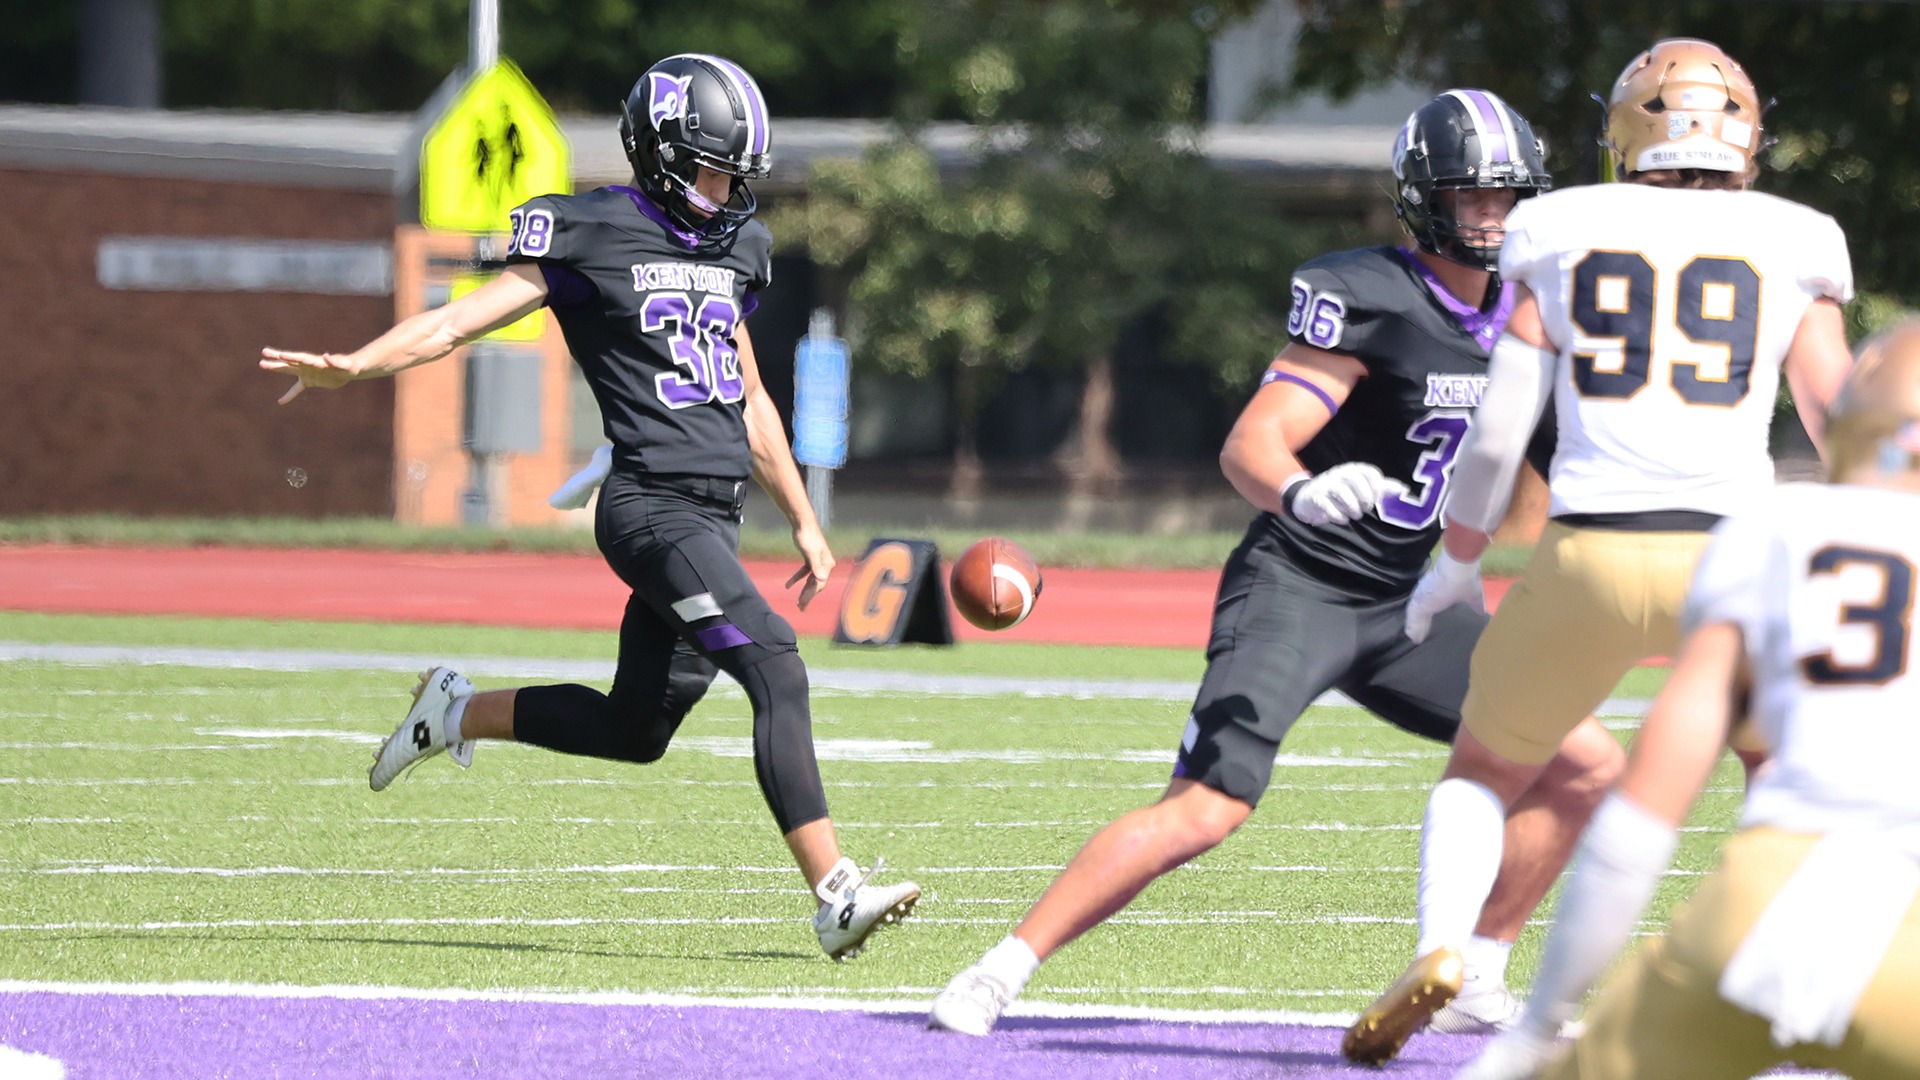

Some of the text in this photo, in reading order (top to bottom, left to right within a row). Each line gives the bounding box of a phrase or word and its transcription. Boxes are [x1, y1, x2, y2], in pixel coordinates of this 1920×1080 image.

[1651, 151, 1680, 162] BLUE
[632, 263, 735, 297] KENYON
[1287, 277, 1346, 349] 36
[1570, 248, 1763, 409] 99
[1424, 372, 1490, 407] KEN
[1375, 410, 1471, 530] 3
[841, 541, 913, 644] G
[1796, 540, 1918, 686] 3
